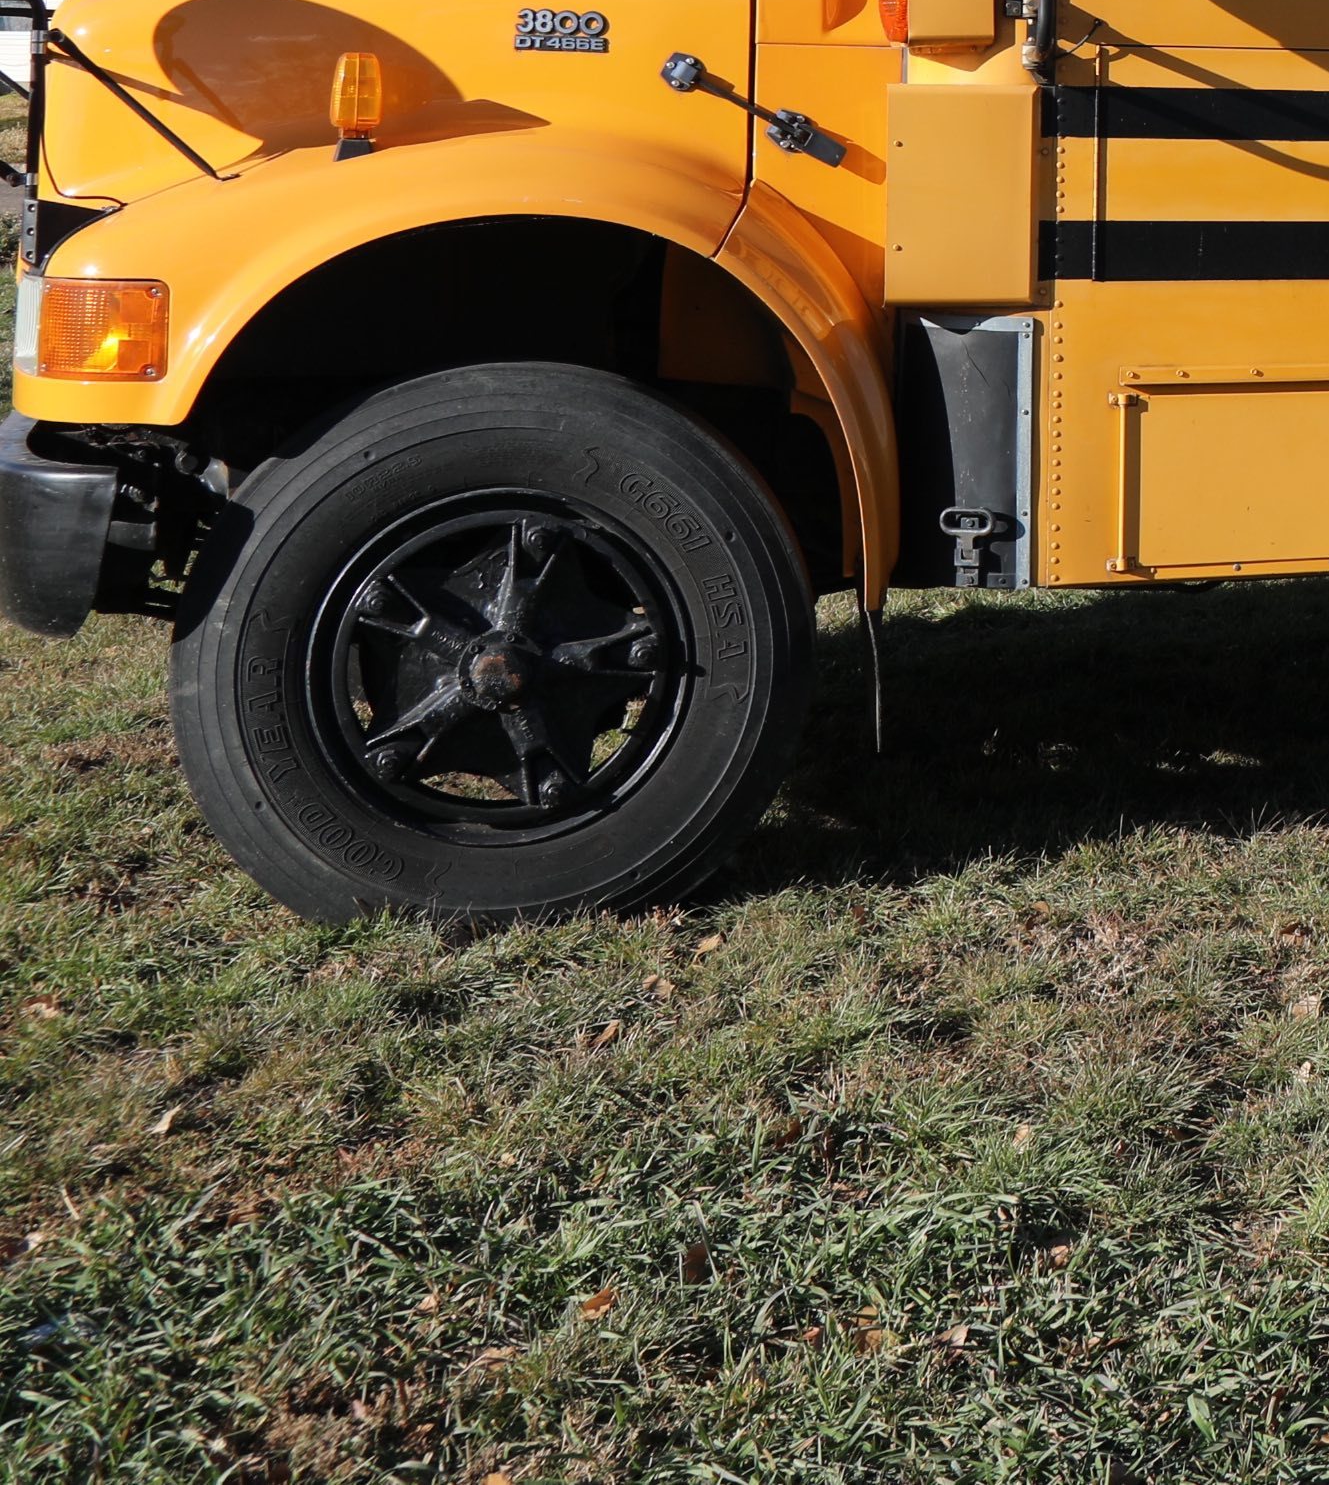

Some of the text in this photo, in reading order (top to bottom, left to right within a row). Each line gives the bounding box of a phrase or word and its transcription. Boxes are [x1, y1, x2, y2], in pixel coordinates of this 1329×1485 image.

[516, 8, 608, 36] 3800
[619, 472, 748, 662] G661 HSA
